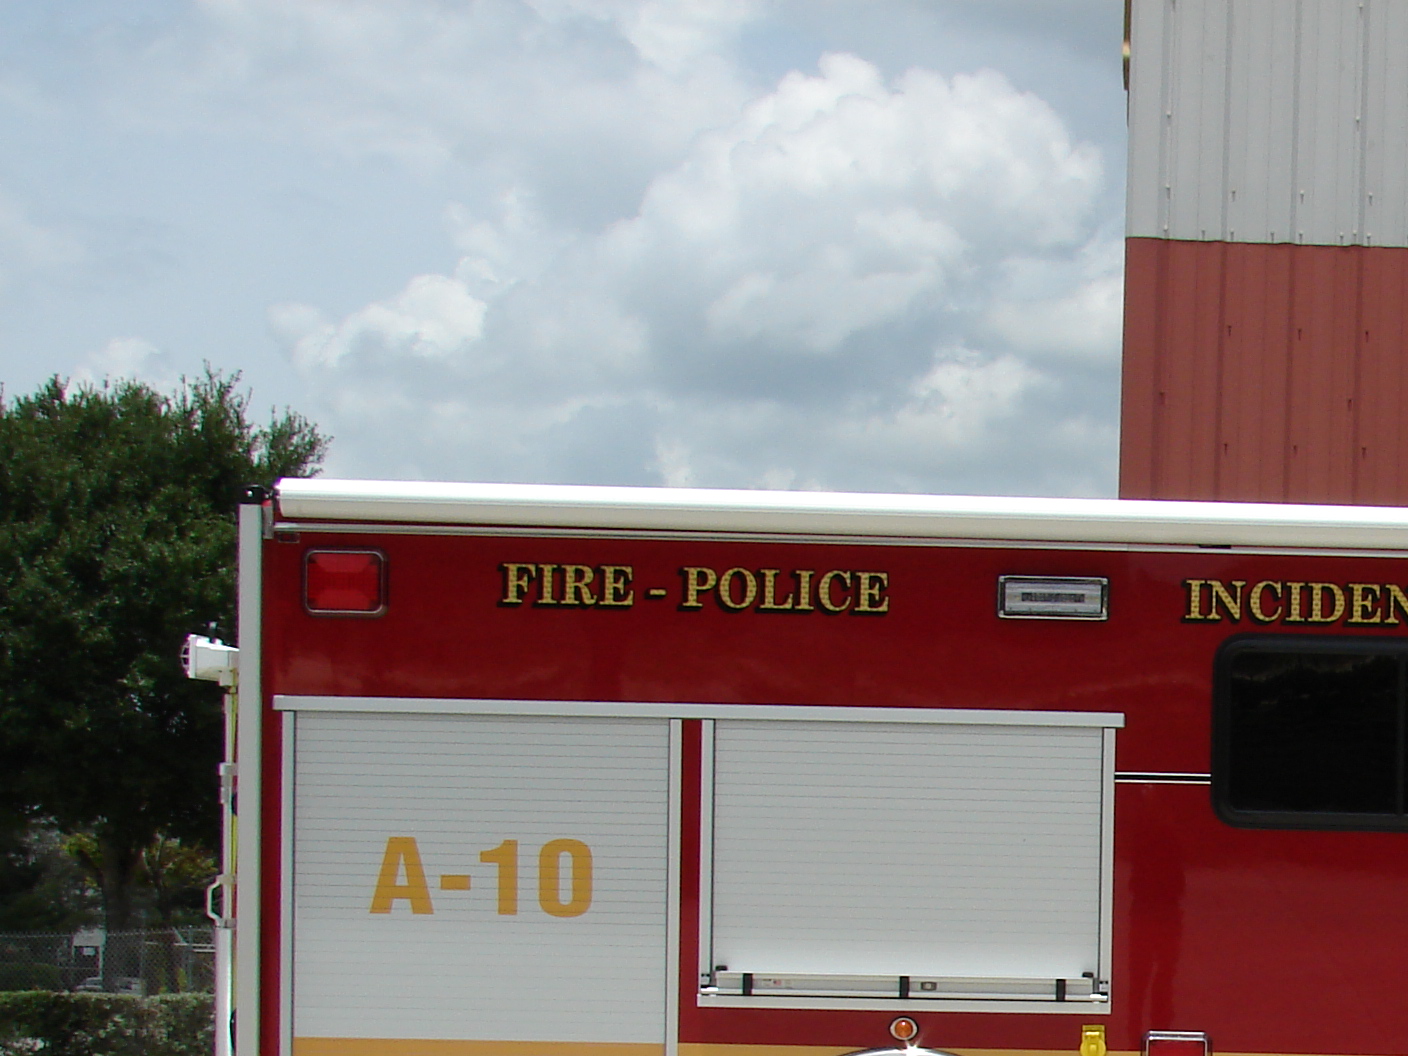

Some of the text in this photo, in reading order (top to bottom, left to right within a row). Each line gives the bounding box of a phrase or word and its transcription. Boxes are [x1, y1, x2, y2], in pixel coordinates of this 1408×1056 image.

[500, 562, 634, 608] FIRE
[680, 566, 890, 614] POLICE
[369, 836, 594, 918] A-10
